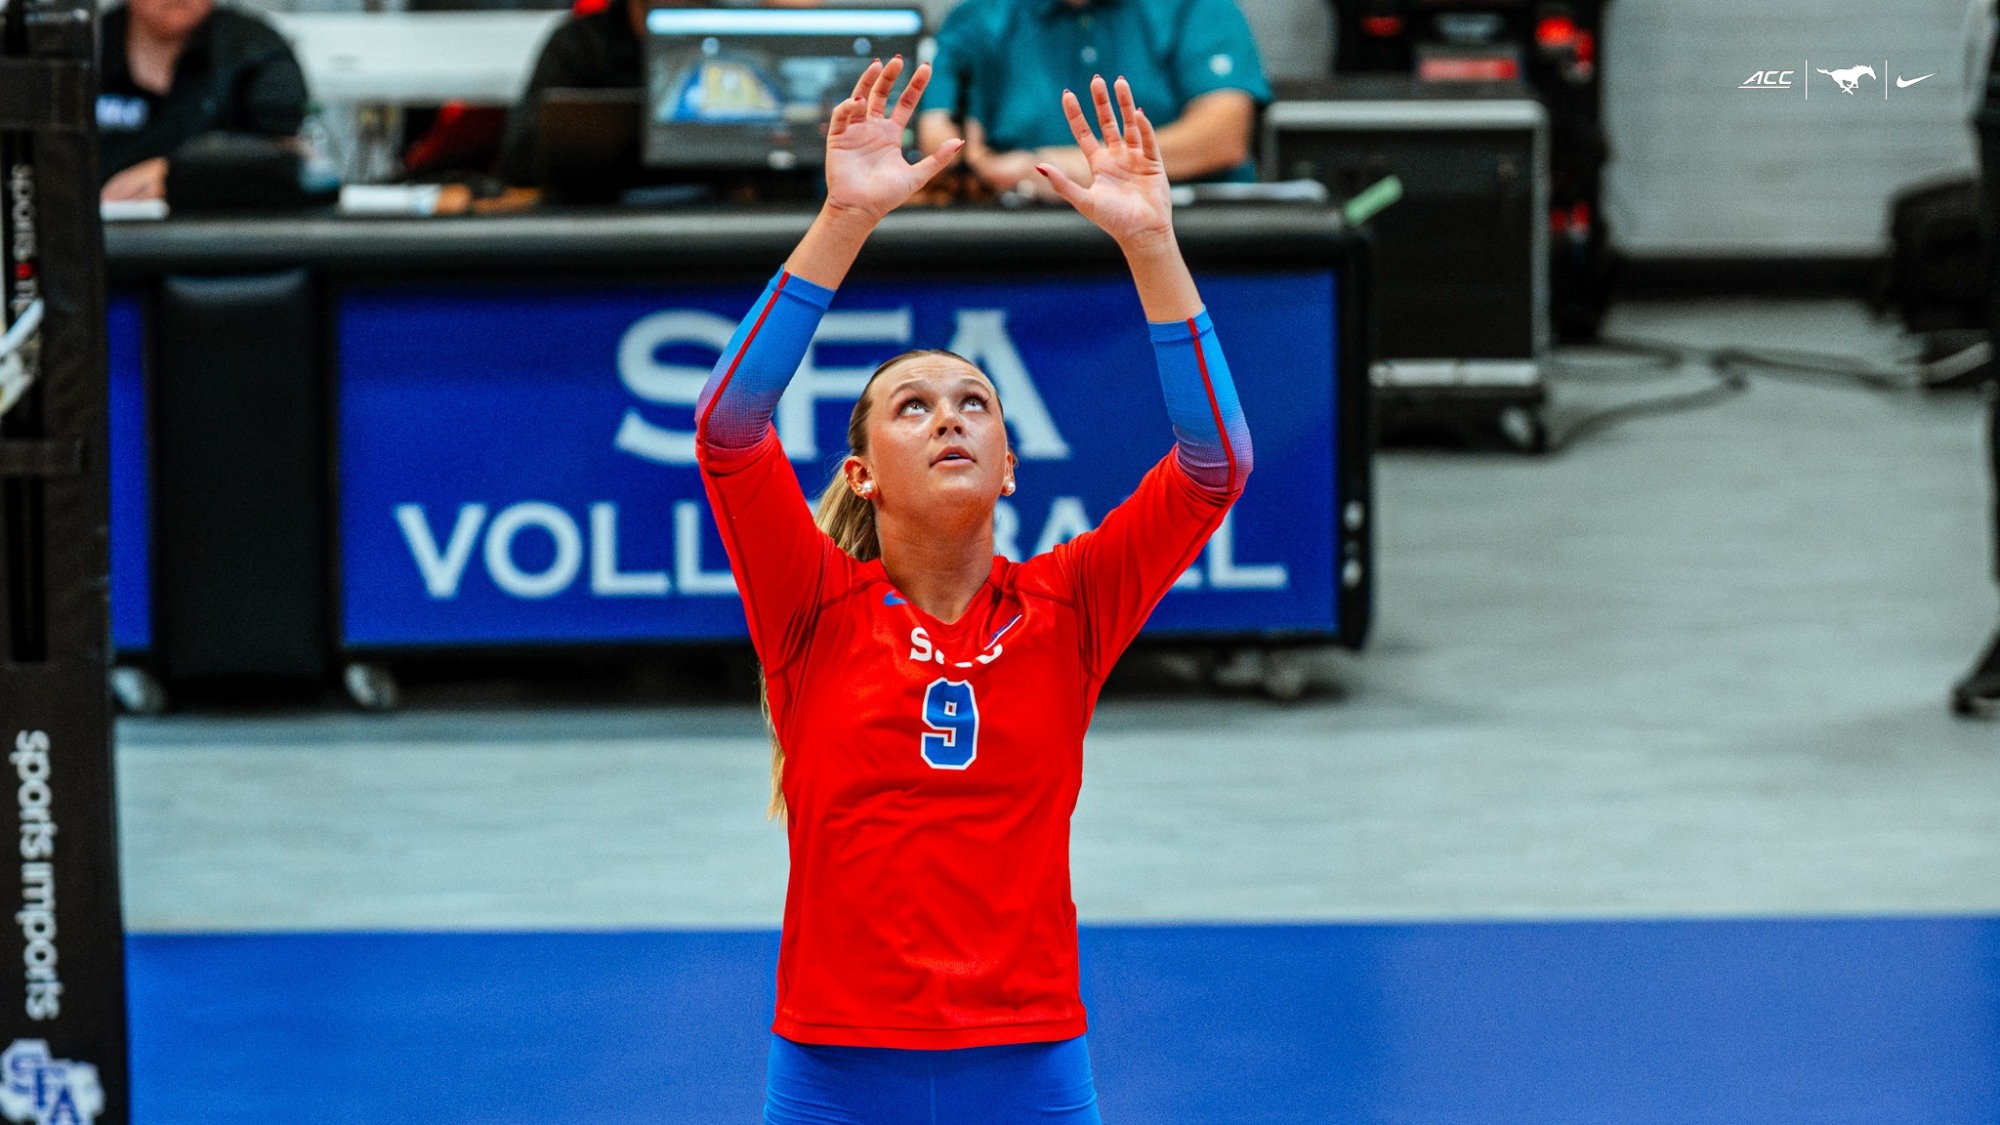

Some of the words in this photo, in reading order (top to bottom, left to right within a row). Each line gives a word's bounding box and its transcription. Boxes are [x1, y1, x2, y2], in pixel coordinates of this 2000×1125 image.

[921, 677, 980, 770] 9
[9, 730, 58, 861] sports
[16, 862, 65, 1021] imports
